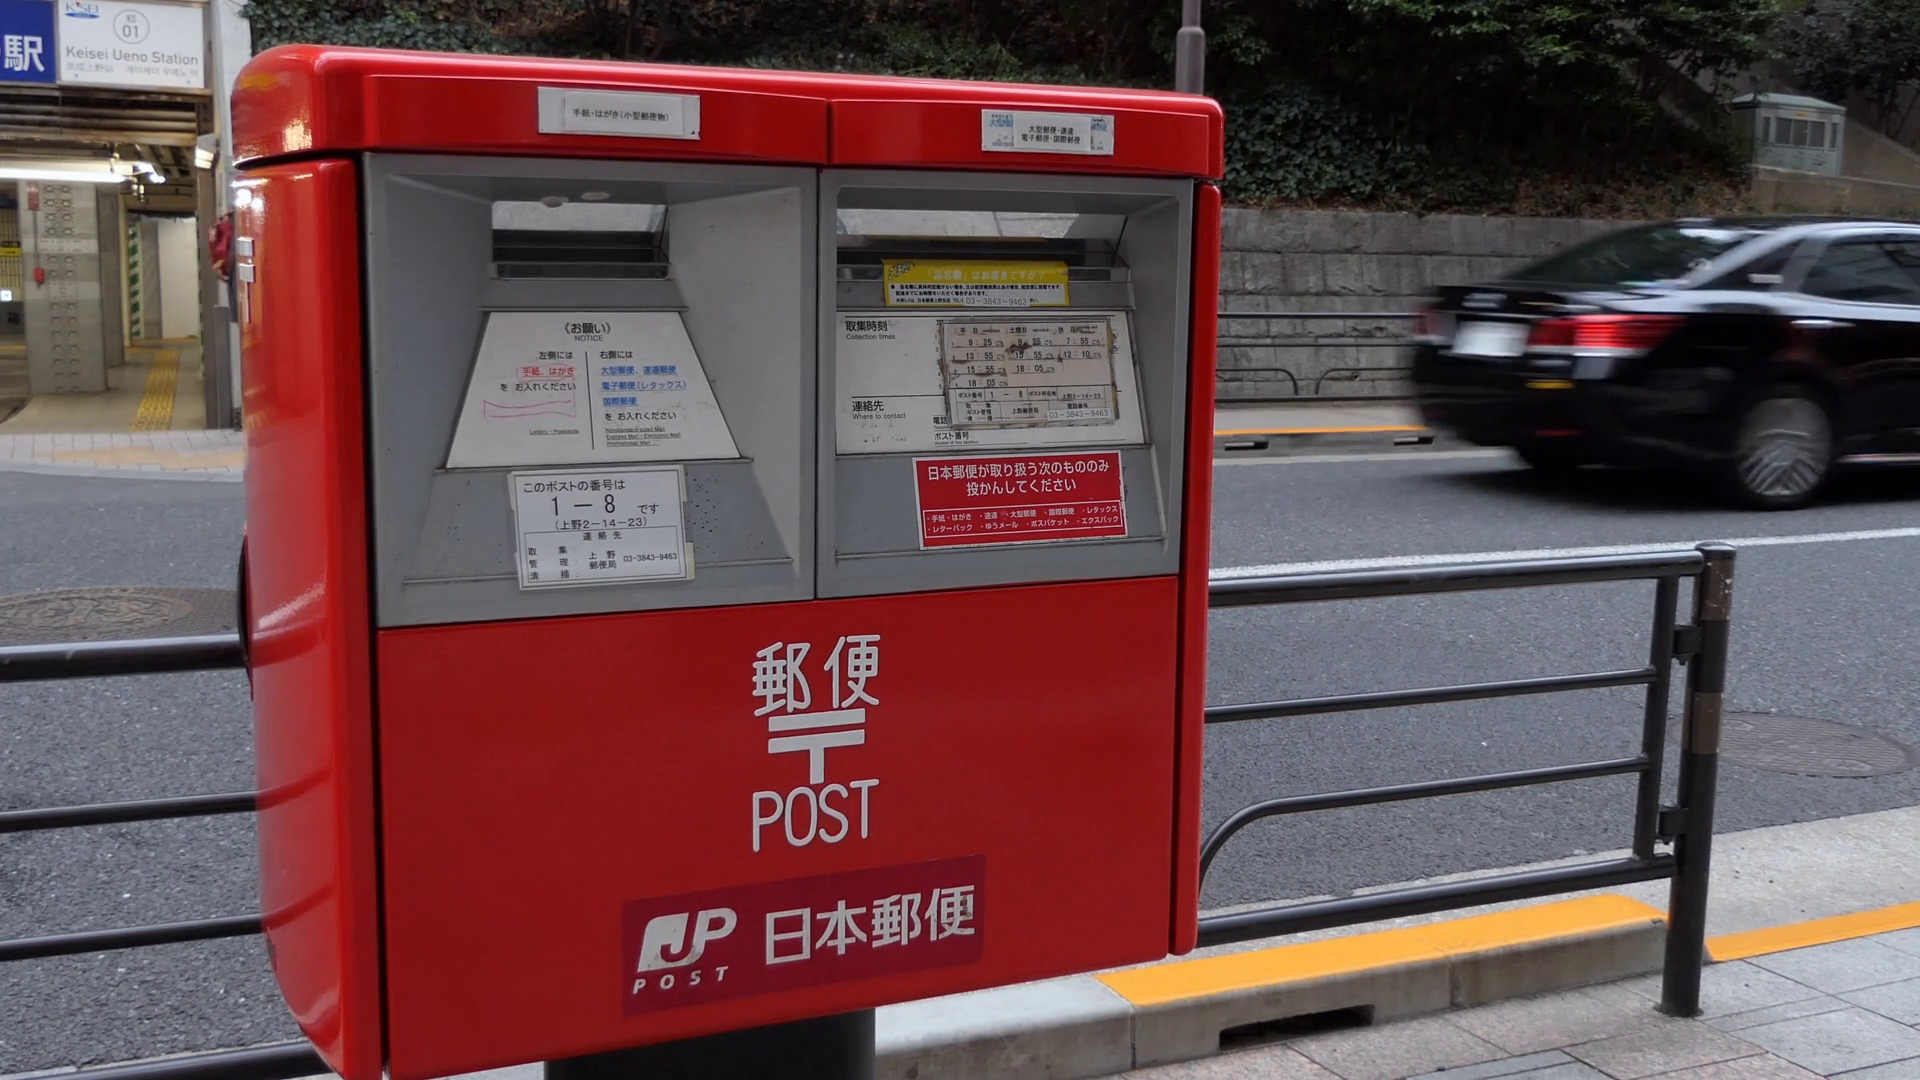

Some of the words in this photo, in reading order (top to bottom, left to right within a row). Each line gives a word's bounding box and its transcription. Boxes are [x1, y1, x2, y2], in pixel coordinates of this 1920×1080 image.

[126, 15, 137, 23] KS
[122, 25, 139, 38] 01
[4, 34, 45, 72] 駅
[66, 46, 109, 60] Keisei
[113, 50, 149, 63] Ueno
[152, 52, 199, 65] Station
[845, 320, 888, 332] 取集時刻
[539, 350, 574, 360] 左側には
[600, 350, 633, 360] 右側には
[515, 382, 577, 392] お入れください
[852, 401, 885, 412] 連絡先
[617, 411, 677, 421] お入れください
[935, 431, 969, 441] ポスト番号
[928, 460, 1110, 481] 日本郵便が取り扱う次のもののみ
[523, 479, 626, 493] このポストの番号は
[967, 478, 1077, 497] 投かんしてください
[638, 503, 660, 514] です
[583, 531, 622, 541] 連絡先
[623, 552, 678, 563] 03-3843-9463
[589, 560, 617, 570] 郵便局
[752, 634, 881, 717] 郵便
[752, 778, 880, 853] POST
[765, 884, 976, 966] 日本郵便
[632, 966, 729, 995] POST
